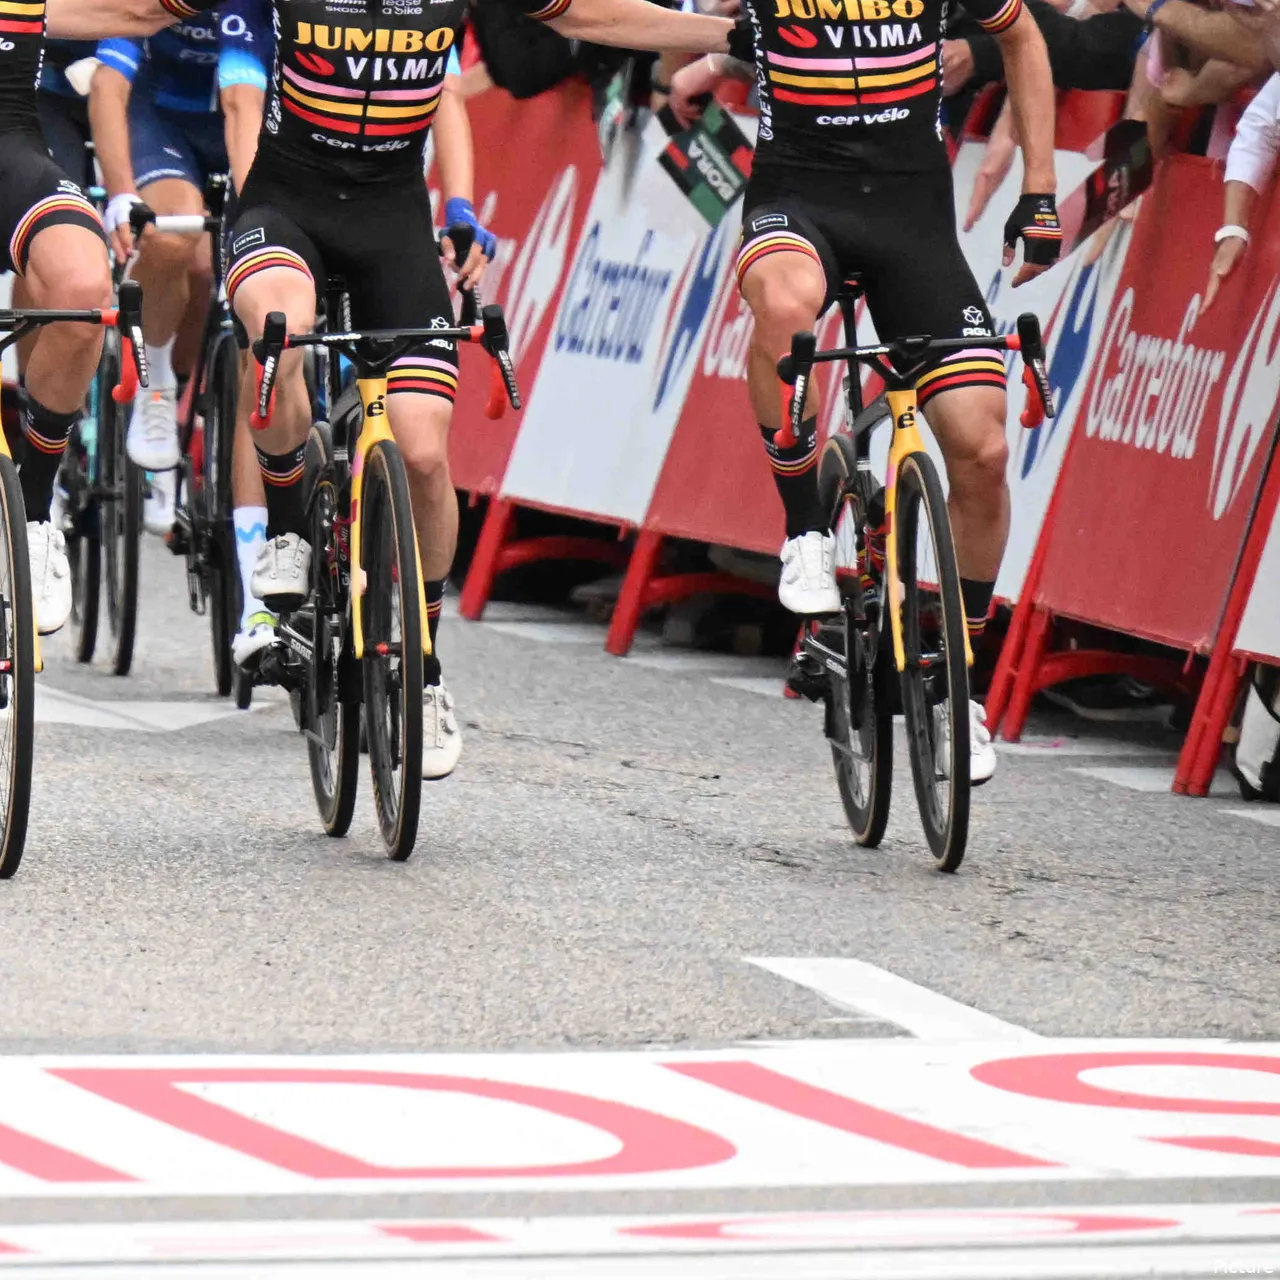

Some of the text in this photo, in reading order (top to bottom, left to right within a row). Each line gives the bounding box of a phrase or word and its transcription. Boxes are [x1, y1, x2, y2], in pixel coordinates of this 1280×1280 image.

[293, 21, 455, 53] JUMBO
[824, 22, 922, 49] VISMA
[346, 56, 443, 81] VISMA
[555, 221, 673, 365] Carrefour
[962, 327, 991, 337] AGU
[259, 355, 275, 406] SRAM
[1085, 286, 1226, 460] Carrefour
